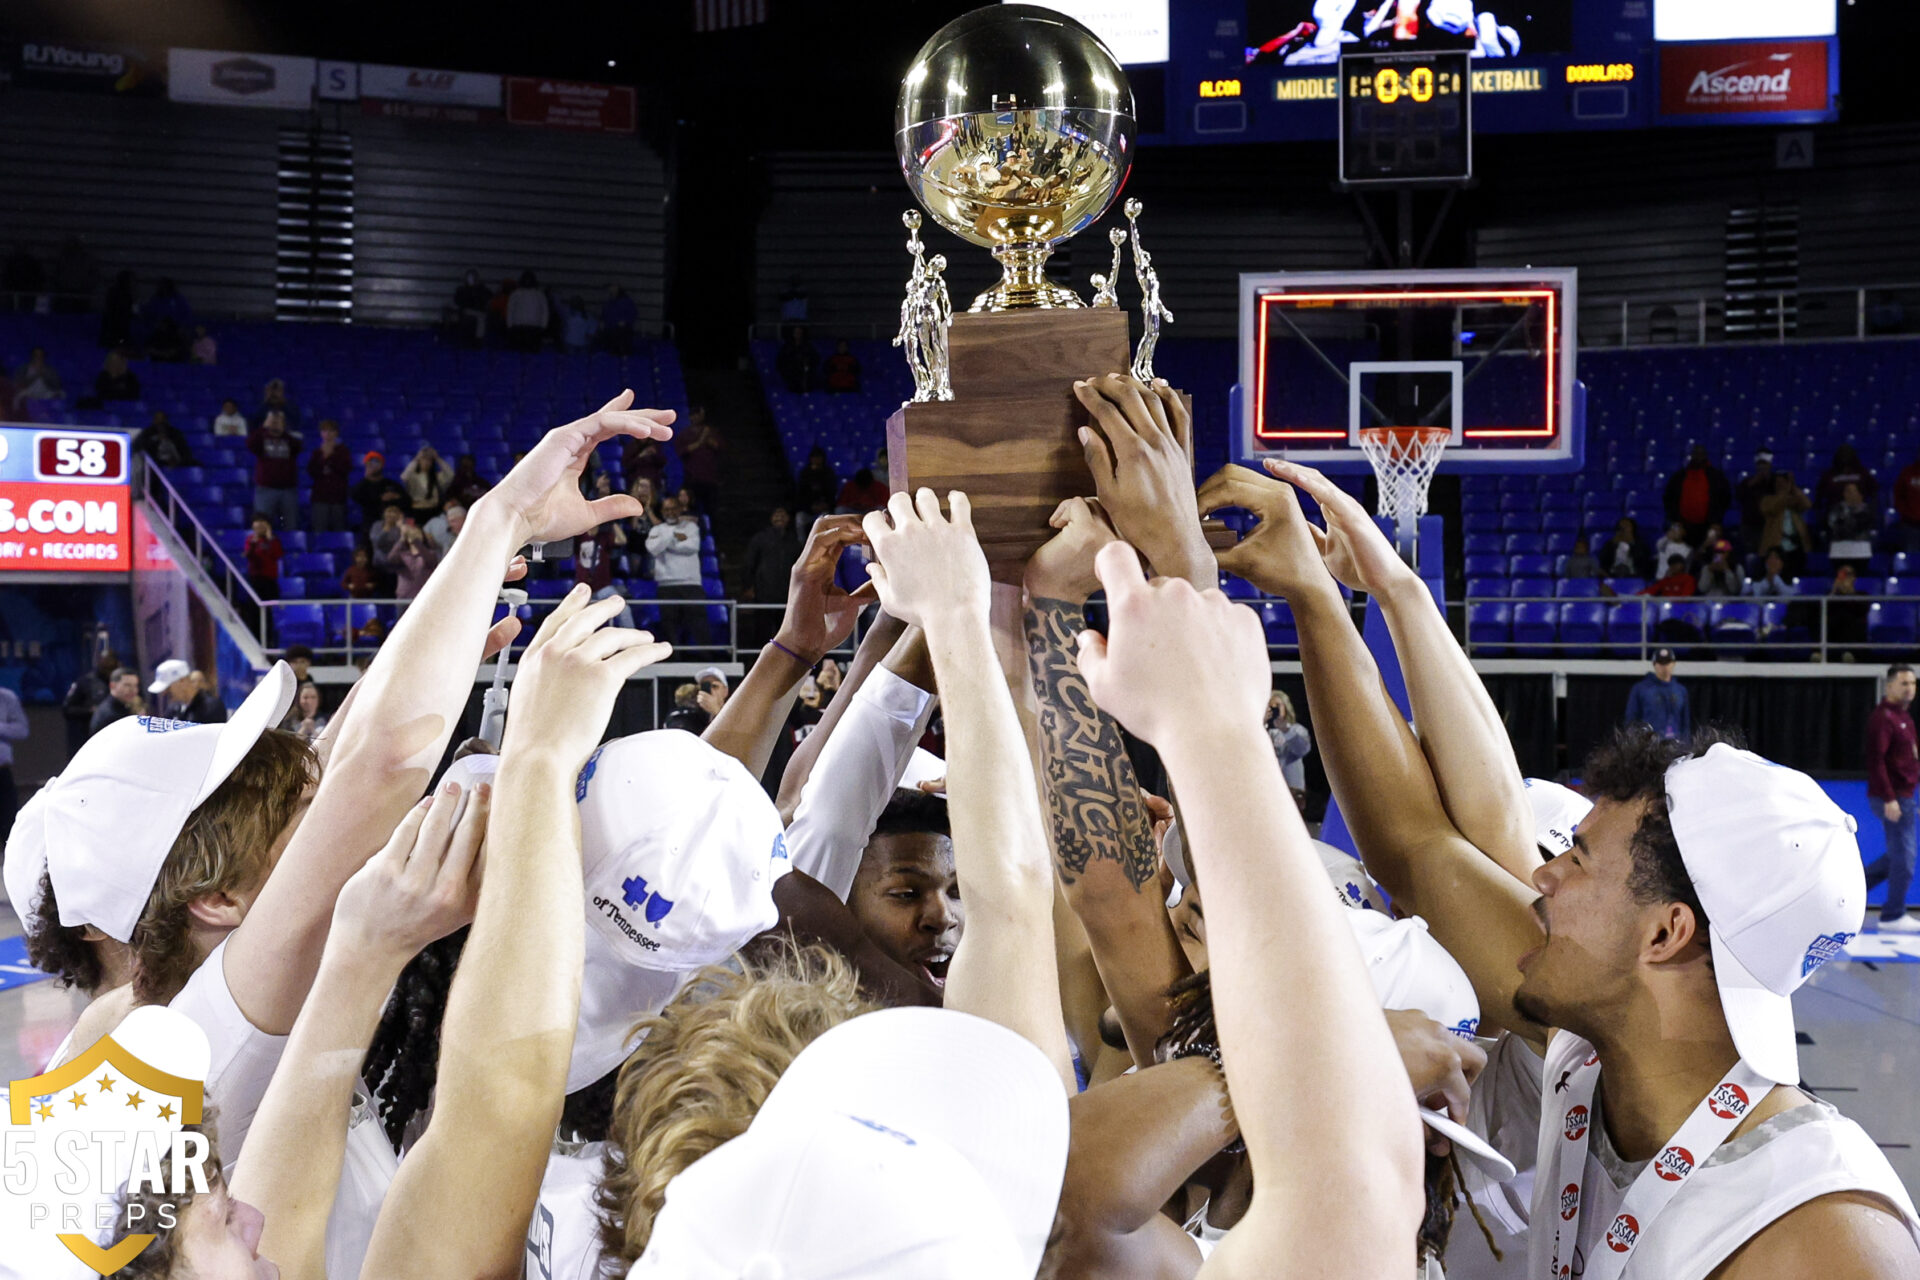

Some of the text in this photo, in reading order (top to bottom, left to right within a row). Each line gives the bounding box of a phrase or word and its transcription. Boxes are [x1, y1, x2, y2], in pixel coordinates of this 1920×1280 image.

[22, 43, 125, 75] RJYoung
[1566, 63, 1634, 83] DOUGLASS
[1688, 68, 1791, 94] Ascend
[1200, 79, 1241, 97] ALCOA
[1277, 78, 1337, 99] MIDDLE
[55, 438, 107, 476] 58
[43, 542, 118, 560] RECORDS
[607, 905, 661, 952] Tennessee
[1713, 1085, 1747, 1115] TSSAA
[1566, 1112, 1588, 1129] TSSAA
[1660, 1148, 1692, 1176] TSSAA
[1611, 1217, 1637, 1246] TSSAA
